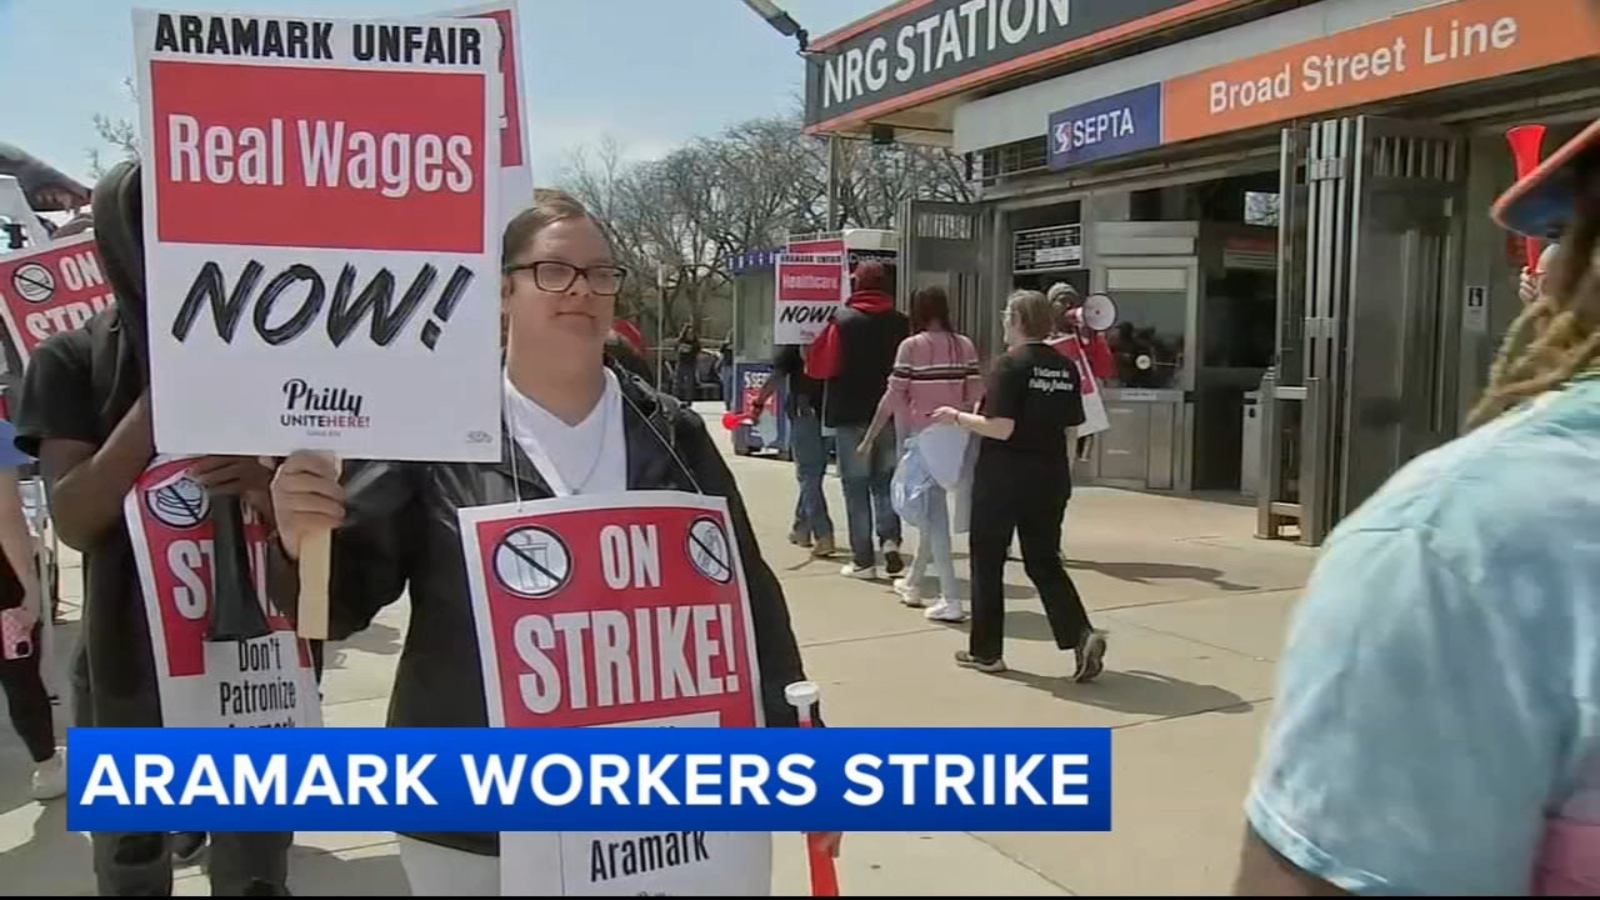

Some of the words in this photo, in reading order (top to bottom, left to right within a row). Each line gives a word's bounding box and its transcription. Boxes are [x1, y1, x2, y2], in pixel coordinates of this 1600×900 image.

[155, 14, 334, 60] ARAMARK
[352, 24, 482, 65] UNFAIR
[823, 37, 888, 108] NRG
[895, 0, 1071, 83] STATION
[1210, 64, 1290, 114] Broad
[1302, 37, 1406, 92] Street
[1424, 15, 1518, 65] Line
[1073, 107, 1135, 147] SEPTA
[168, 113, 283, 186] Real
[297, 119, 473, 198] Wages
[59, 251, 105, 291] ON
[171, 259, 475, 352] NOW!
[282, 378, 364, 417] Philly
[600, 524, 661, 590] ON
[238, 638, 283, 672] Don't
[513, 603, 740, 715] STRIKE!
[219, 678, 297, 717] Patronize
[590, 830, 711, 883] Aramark
